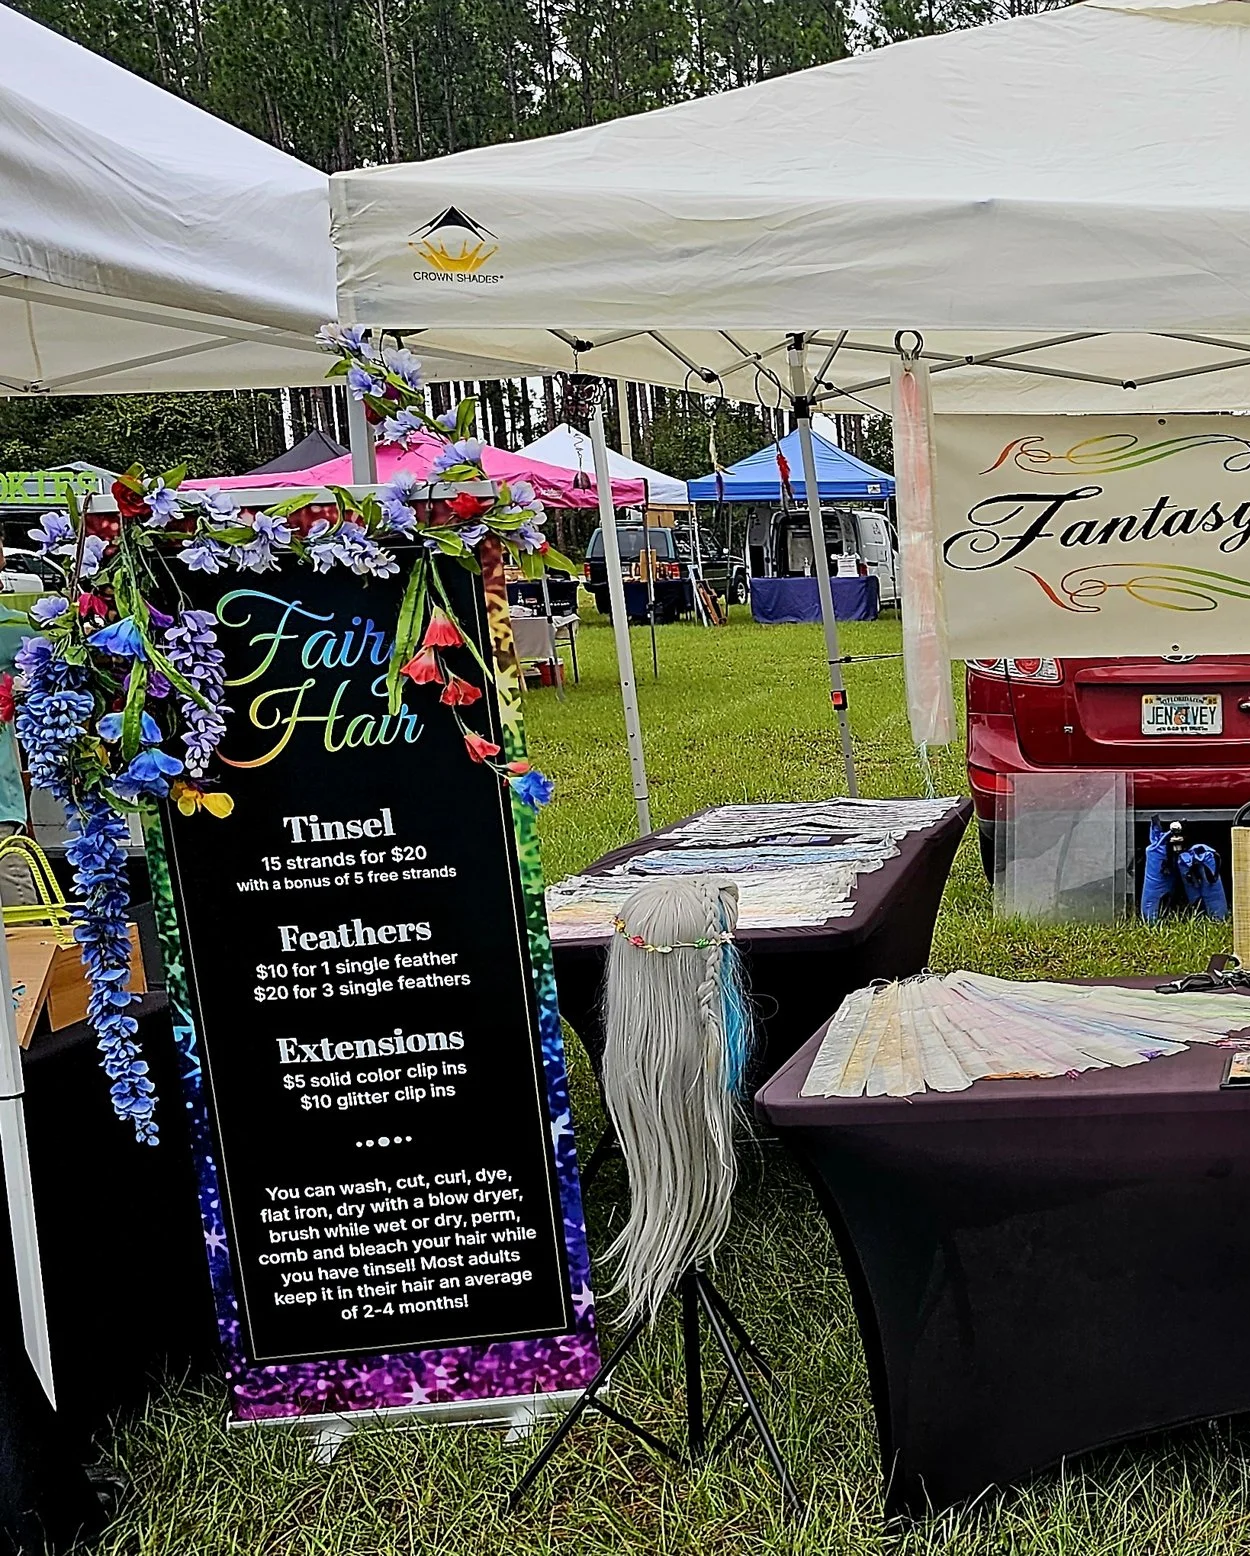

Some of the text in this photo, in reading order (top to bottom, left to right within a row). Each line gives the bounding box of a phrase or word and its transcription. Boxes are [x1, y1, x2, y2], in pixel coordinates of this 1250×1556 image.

[413, 272, 453, 282] CROWN
[216, 589, 408, 697] Fair
[215, 678, 424, 768] Hair
[283, 808, 396, 843] Tinsel
[262, 846, 426, 871] 15 strands for $20
[237, 865, 456, 891] with a bonus of 5 free strands
[278, 919, 431, 951] Feathers
[256, 952, 458, 980] $10 for 1 single feather
[254, 974, 471, 1002] $20 for 3 single feathers
[276, 1028, 464, 1066] Extensions
[283, 1061, 467, 1090] $5 solid color clip ins
[301, 1084, 455, 1110] $10 glitter clip ins
[266, 1168, 512, 1200] You can wash, cut, curl, dye,
[260, 1189, 523, 1223] flat iron, dry with a blow dryer,
[269, 1210, 520, 1243] brush while wet or dry, perm,
[259, 1227, 536, 1265] comb and bleach your hair while
[281, 1250, 520, 1287] you have tinsel! Most adults
[275, 1271, 532, 1305] keep it in their hair an average
[342, 1294, 468, 1319] of 2-4 months!
